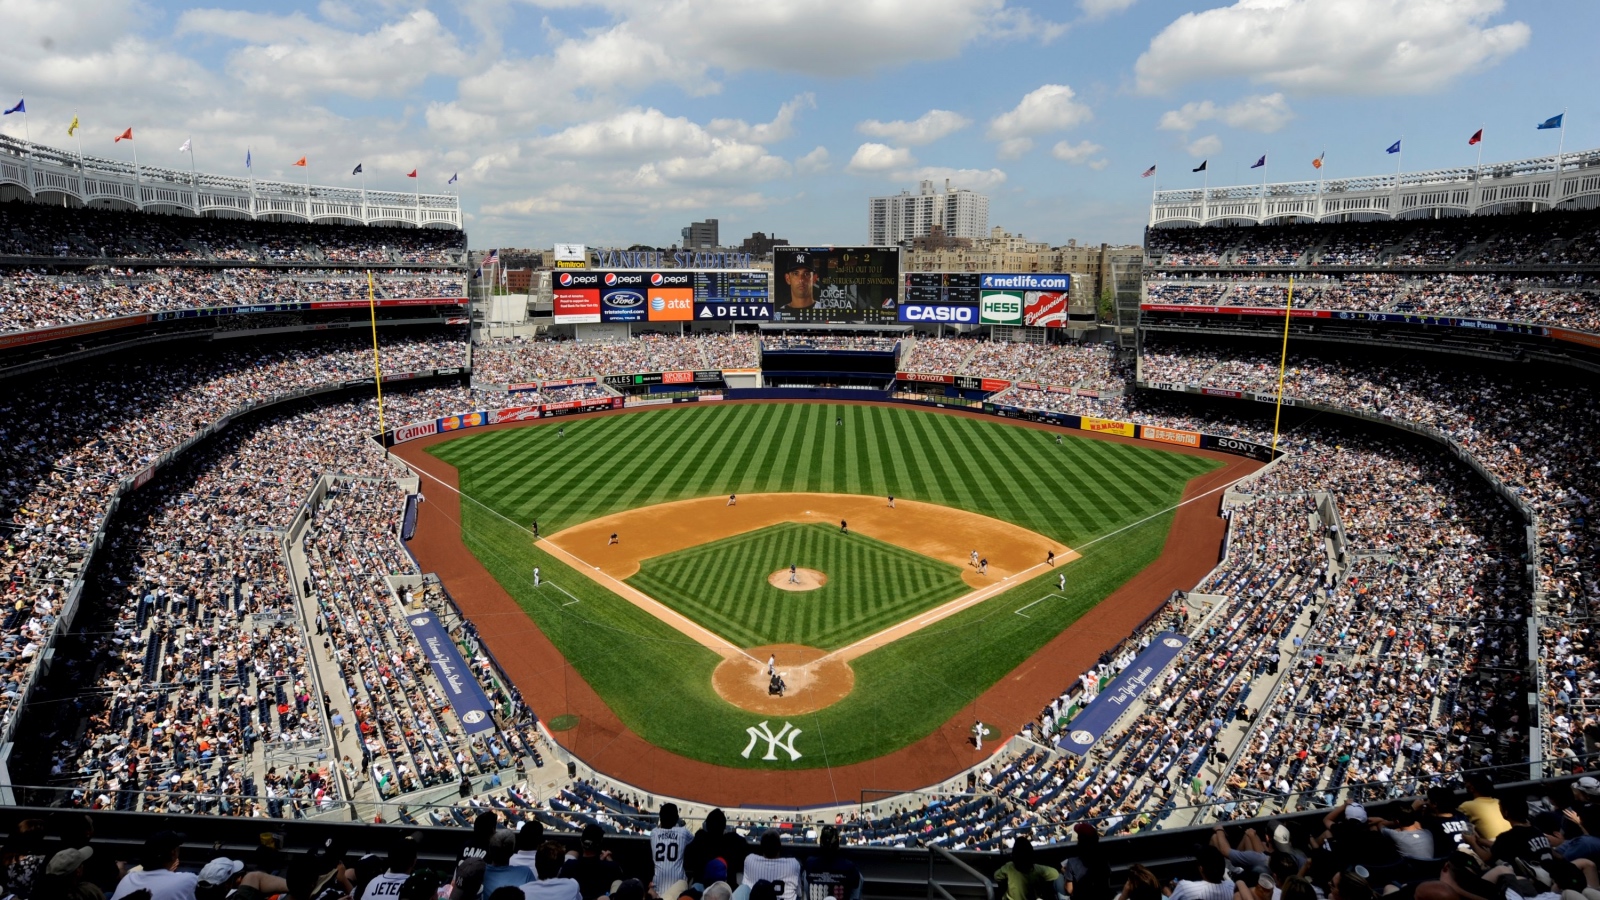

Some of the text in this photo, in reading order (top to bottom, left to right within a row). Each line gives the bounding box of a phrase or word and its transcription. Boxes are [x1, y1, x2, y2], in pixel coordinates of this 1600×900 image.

[596, 251, 751, 268] YANKEE STADIUM
[864, 254, 870, 262] 2
[557, 260, 585, 268] Armitron
[573, 275, 598, 285] pepsi
[617, 275, 642, 284] pepsi
[663, 275, 688, 284] pepsi
[994, 275, 1066, 288] metlife.com
[820, 289, 844, 298] JORGE
[613, 295, 635, 304] Ford
[667, 299, 691, 309] at&t
[820, 299, 853, 309] POSADA
[717, 306, 769, 317] DELTA
[984, 302, 1019, 313] HESS
[1024, 292, 1068, 325] Budweiser
[906, 306, 972, 322] CASIO
[606, 375, 631, 384] ZALES
[917, 373, 944, 382] TOYOTA
[1159, 383, 1173, 391] UTZ
[396, 423, 435, 441] Canon
[1218, 438, 1257, 453] SONY
[741, 720, 803, 761] NY
[463, 846, 487, 859] CANO
[655, 842, 679, 862] 20
